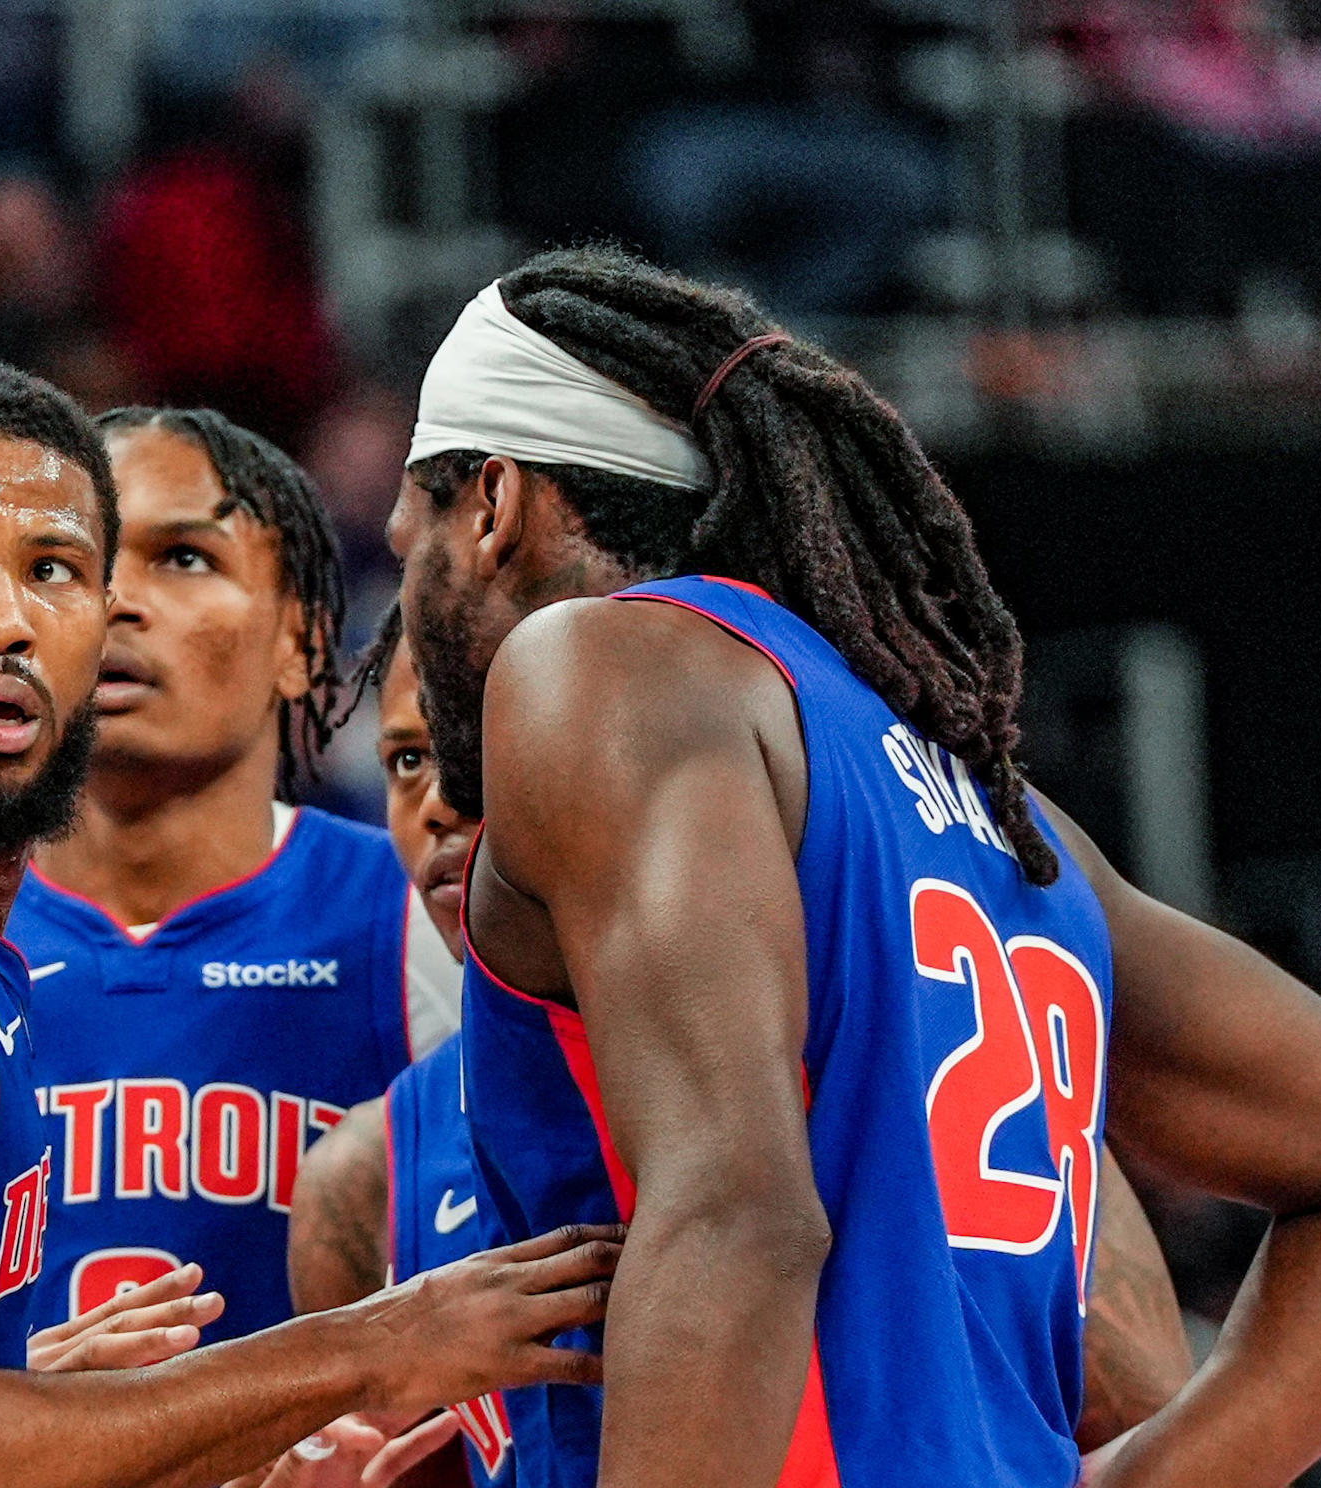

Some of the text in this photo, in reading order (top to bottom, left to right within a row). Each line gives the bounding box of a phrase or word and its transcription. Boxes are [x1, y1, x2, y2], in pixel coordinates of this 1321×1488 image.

[201, 959, 339, 988] StockX
[35, 1077, 349, 1215] TROI
[910, 878, 1105, 1316] 28
